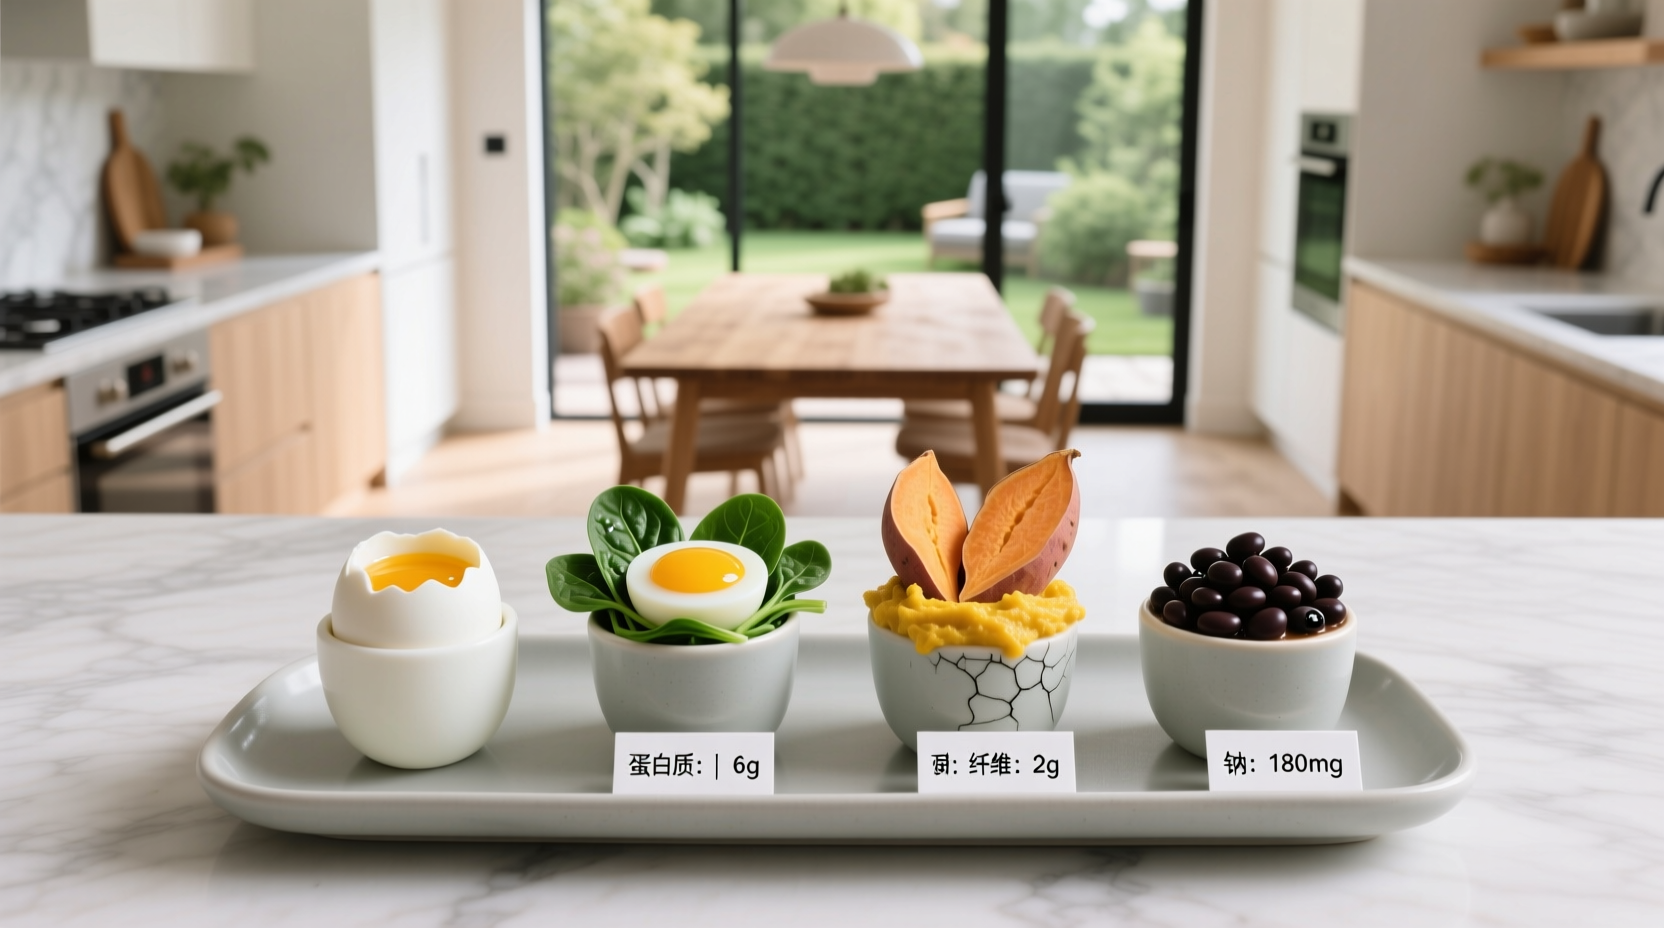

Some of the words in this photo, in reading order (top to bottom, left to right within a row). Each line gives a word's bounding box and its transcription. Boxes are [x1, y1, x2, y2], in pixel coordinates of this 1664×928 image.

[733, 754, 760, 780] 6g
[1032, 753, 1059, 780] 2g
[1269, 753, 1343, 779] 180mg
